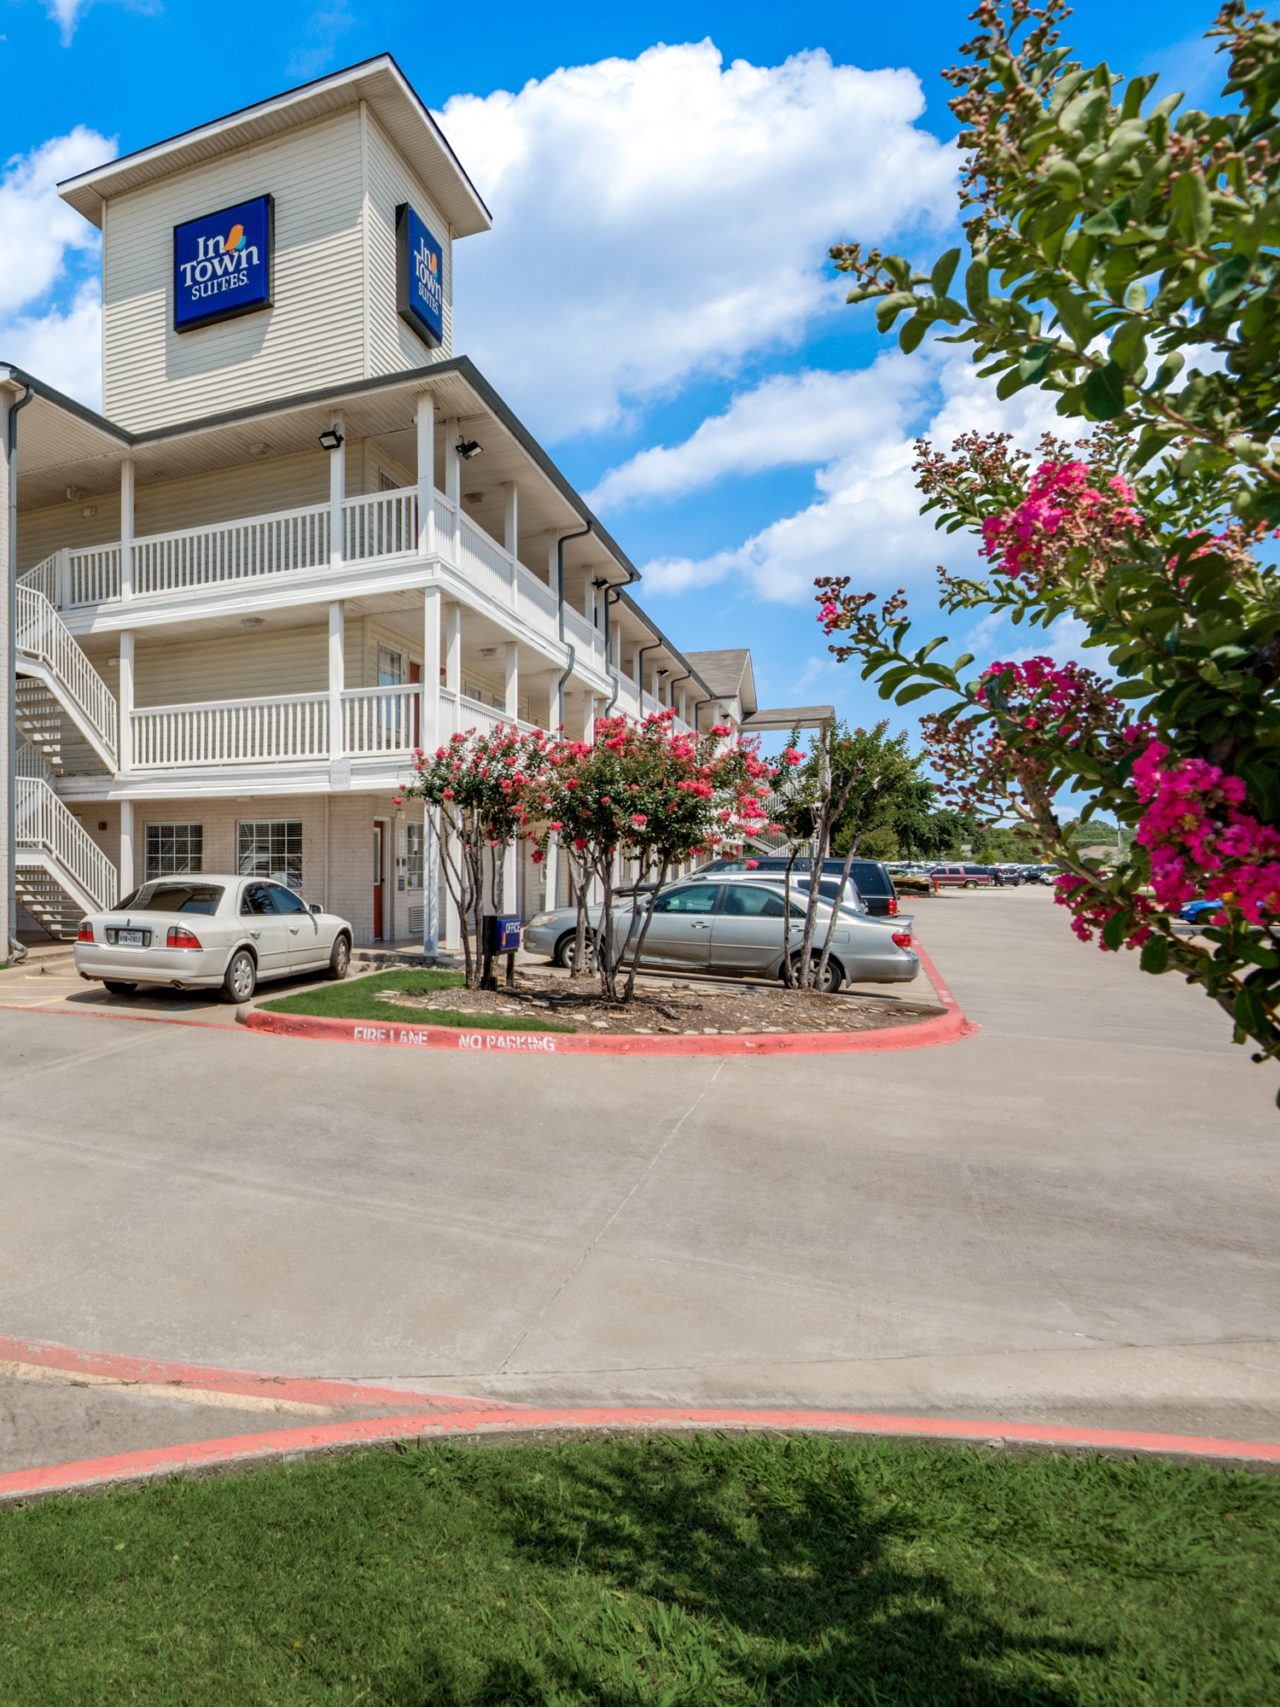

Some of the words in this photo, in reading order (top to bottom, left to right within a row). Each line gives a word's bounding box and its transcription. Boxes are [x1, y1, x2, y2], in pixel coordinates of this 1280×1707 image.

[197, 234, 225, 262] In
[420, 236, 432, 272] In
[191, 271, 248, 300] SUITES
[418, 281, 439, 316] SUITES
[505, 921, 521, 934] OFFICE
[353, 1026, 386, 1040] FIRE
[458, 1034, 483, 1050] NO
[486, 1034, 556, 1052] PARKING
